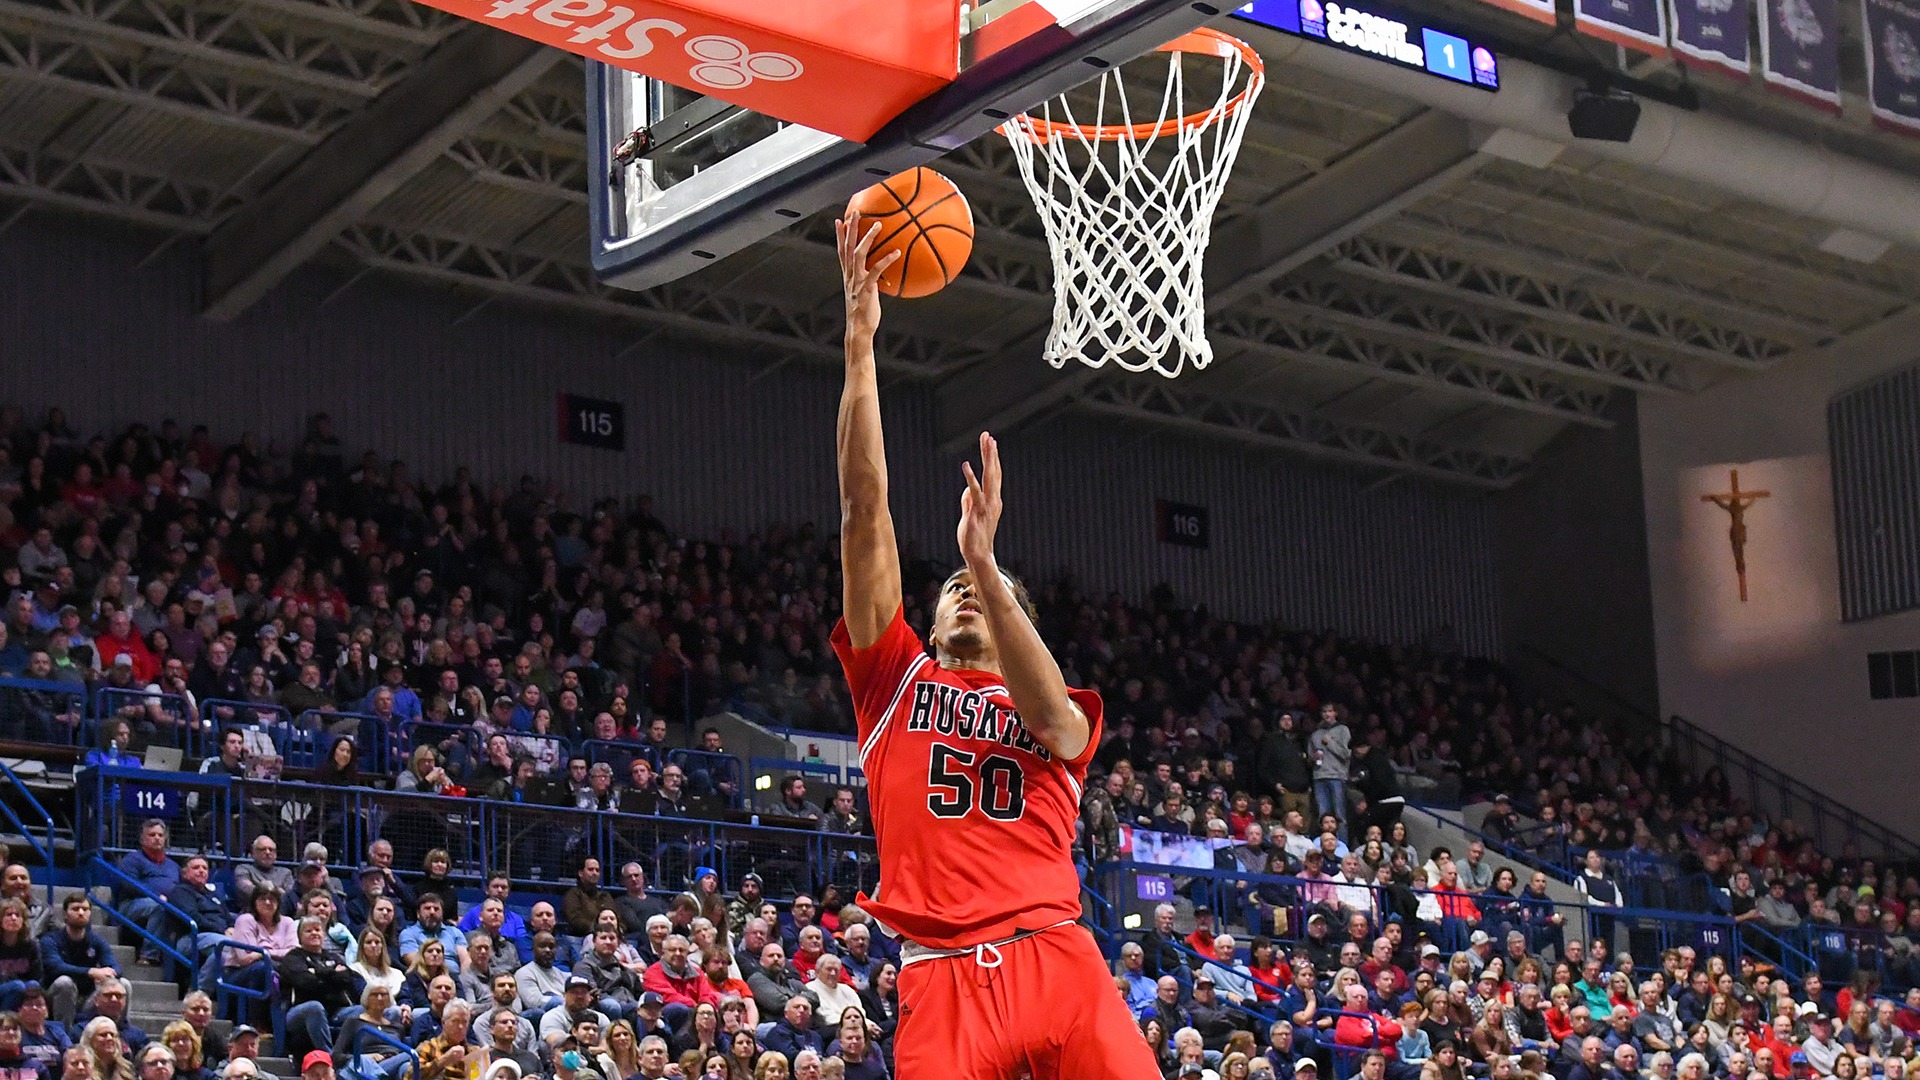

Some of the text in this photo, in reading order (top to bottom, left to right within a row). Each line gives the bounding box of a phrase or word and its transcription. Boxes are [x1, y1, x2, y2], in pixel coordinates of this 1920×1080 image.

[482, 0, 687, 59] Stat
[1326, 21, 1425, 67] COUNTER
[1442, 43, 1456, 69] 1
[580, 410, 613, 436] 115
[1173, 513, 1200, 537] 116
[927, 742, 1026, 822] 50
[136, 790, 166, 810] 114
[1145, 880, 1167, 897] 115
[1702, 930, 1720, 945] 115
